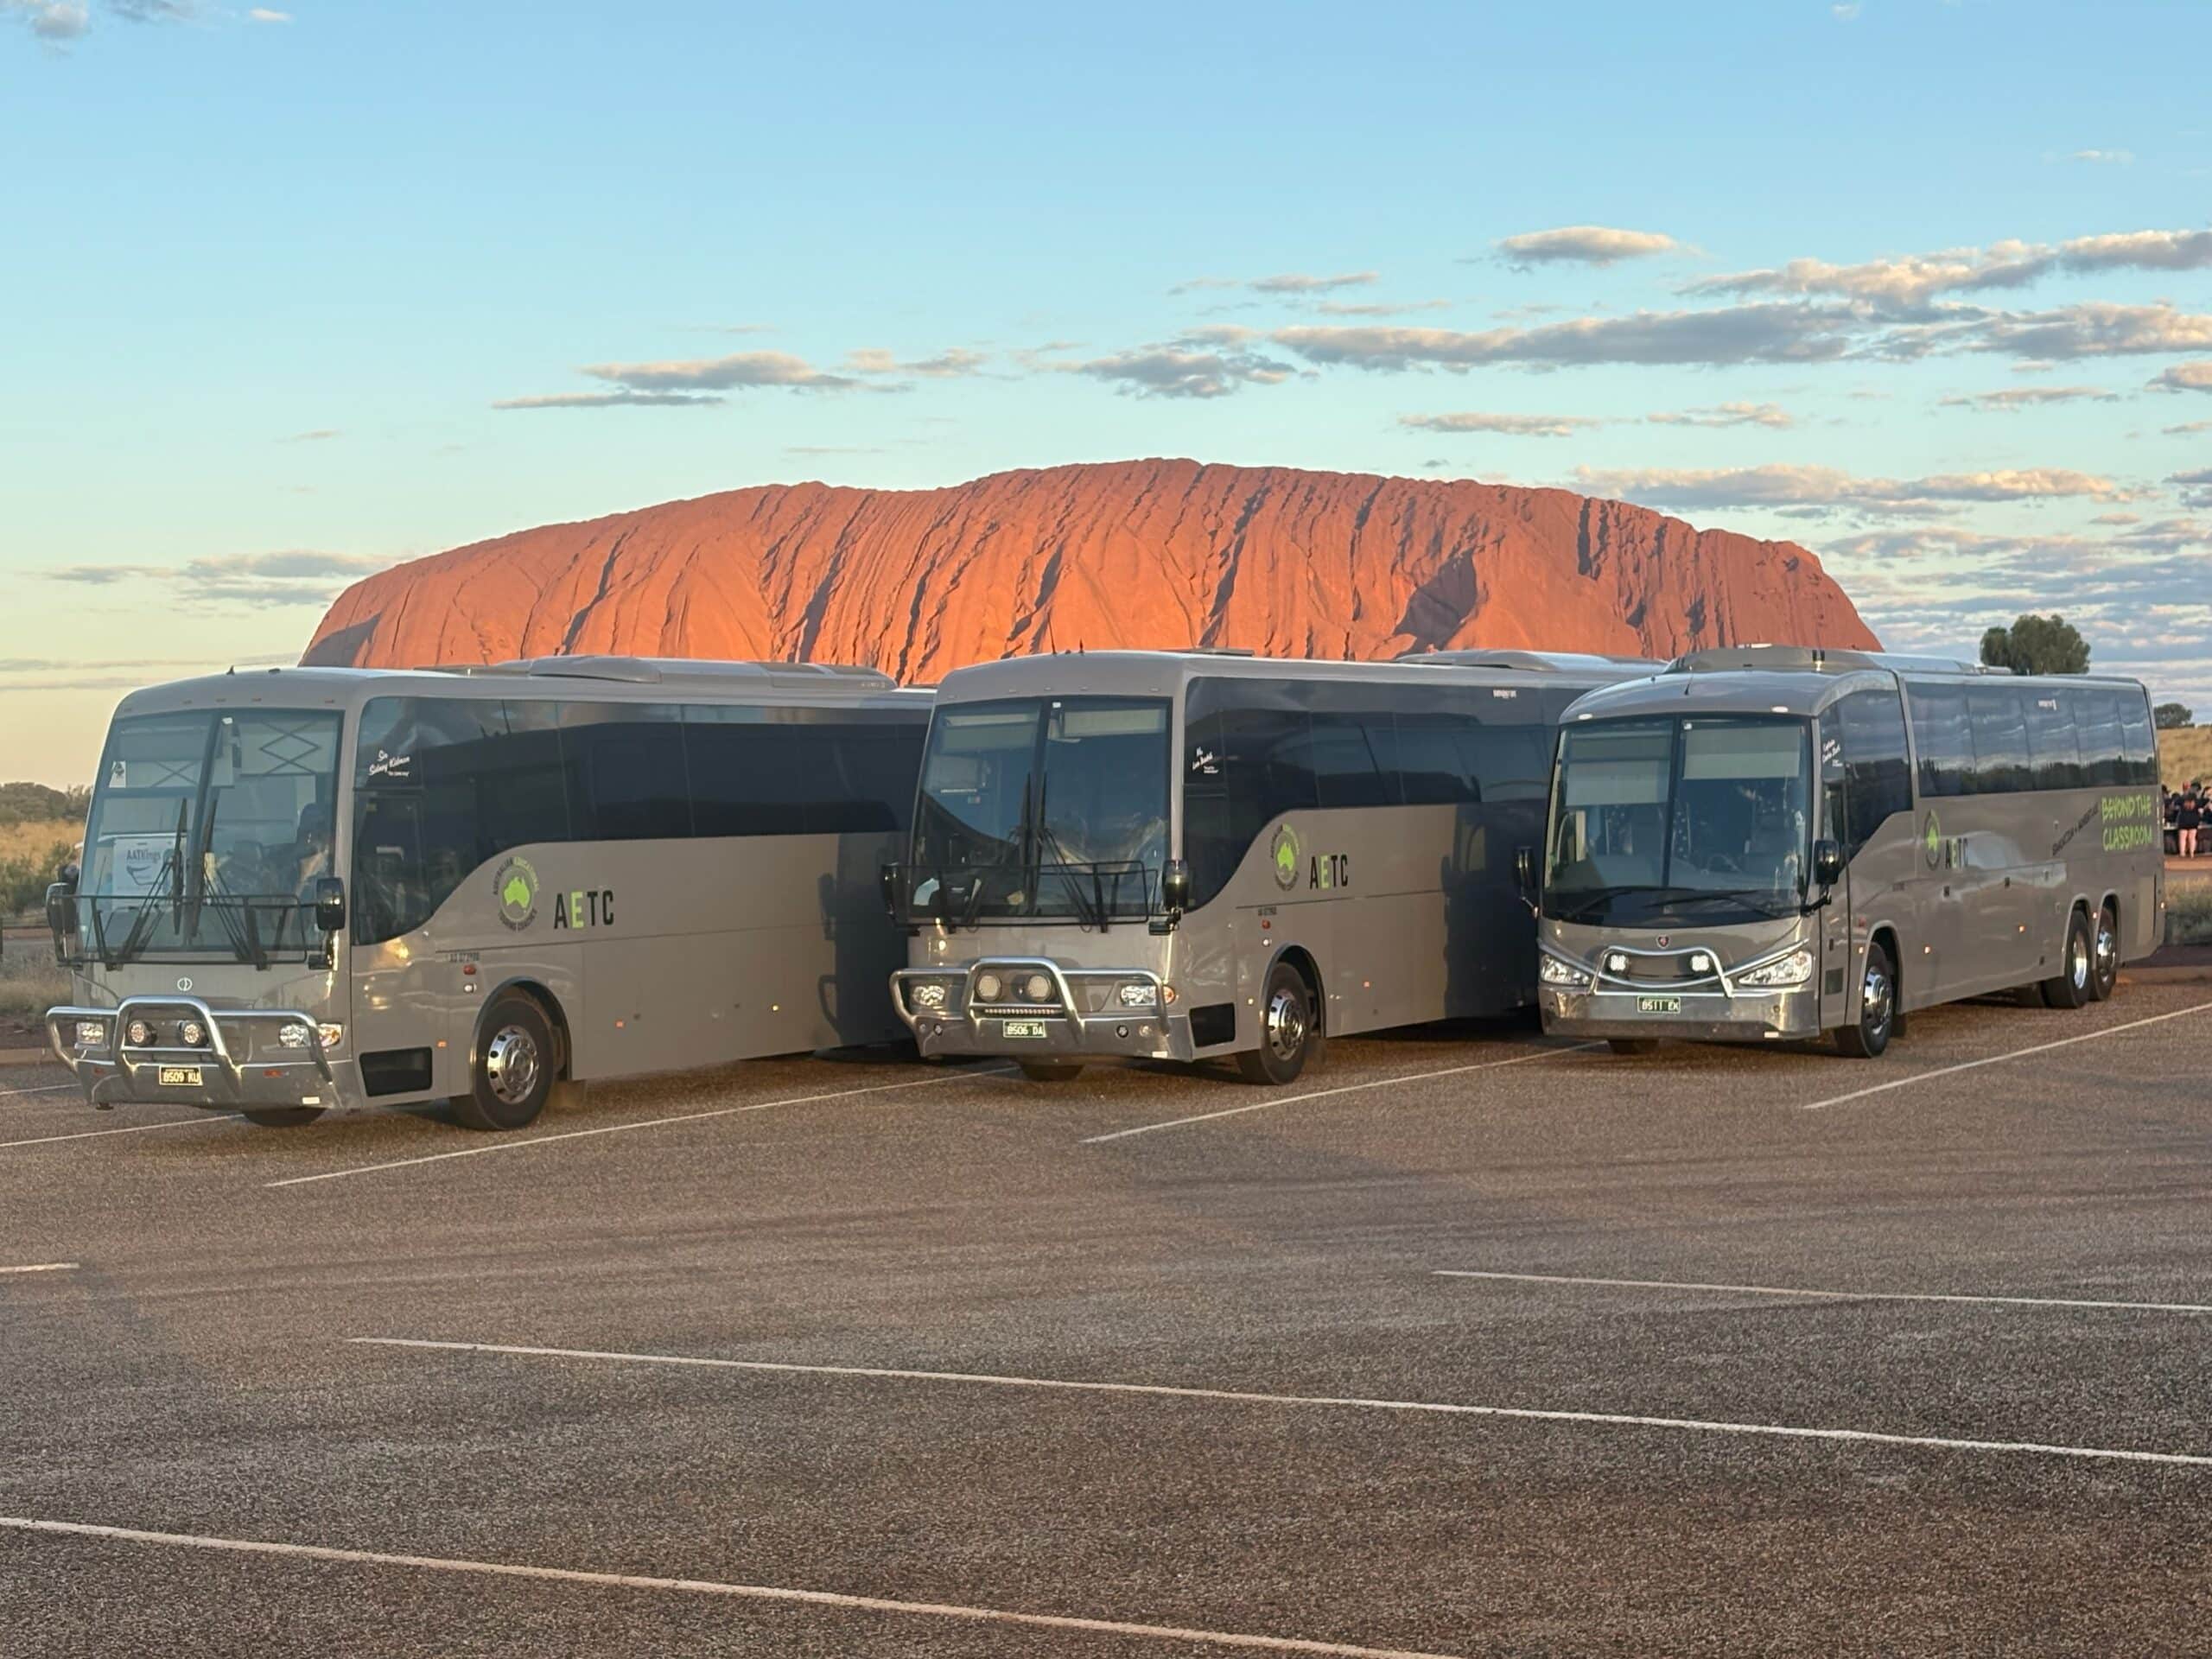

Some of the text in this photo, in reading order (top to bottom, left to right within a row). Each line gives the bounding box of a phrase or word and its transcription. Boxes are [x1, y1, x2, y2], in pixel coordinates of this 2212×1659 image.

[2101, 794, 2152, 823] BEYOND THE
[1944, 837, 1969, 870] AETC
[2101, 823, 2153, 852] CLASSROOM
[1309, 854, 1349, 891] AETC
[554, 889, 614, 930] AETC
